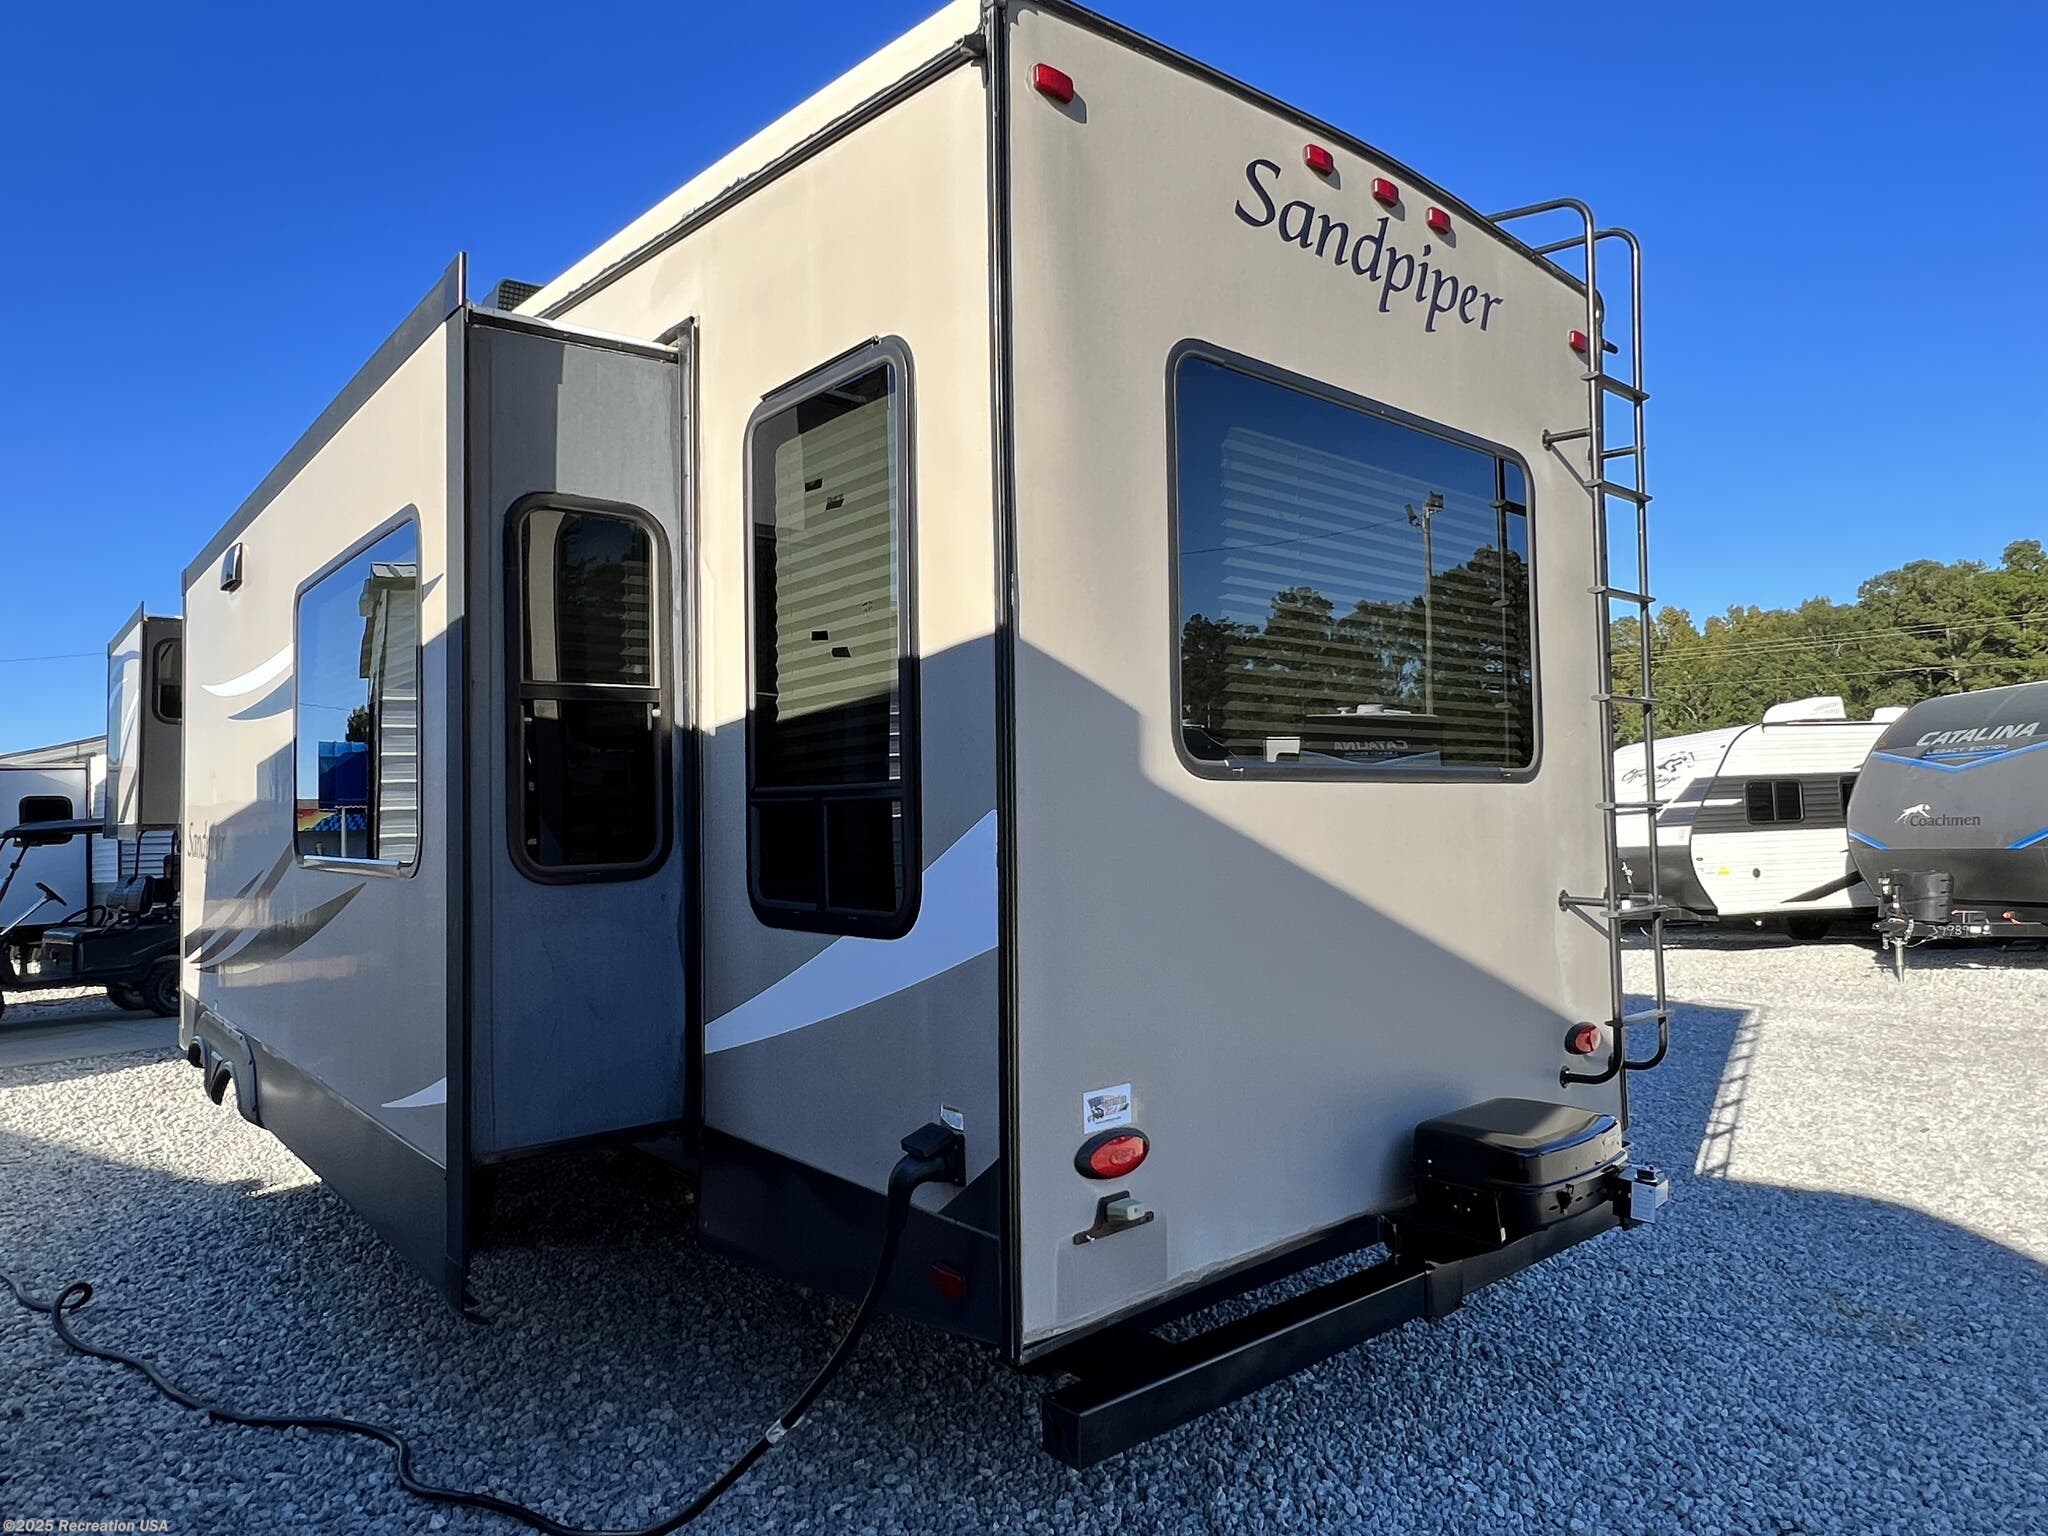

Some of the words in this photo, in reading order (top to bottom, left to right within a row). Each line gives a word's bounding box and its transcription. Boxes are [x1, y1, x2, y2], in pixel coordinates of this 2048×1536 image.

[1234, 158, 1504, 333] Sandpiper
[1916, 722, 2040, 747] CATALINA
[1910, 814, 1981, 827] Coachmen
